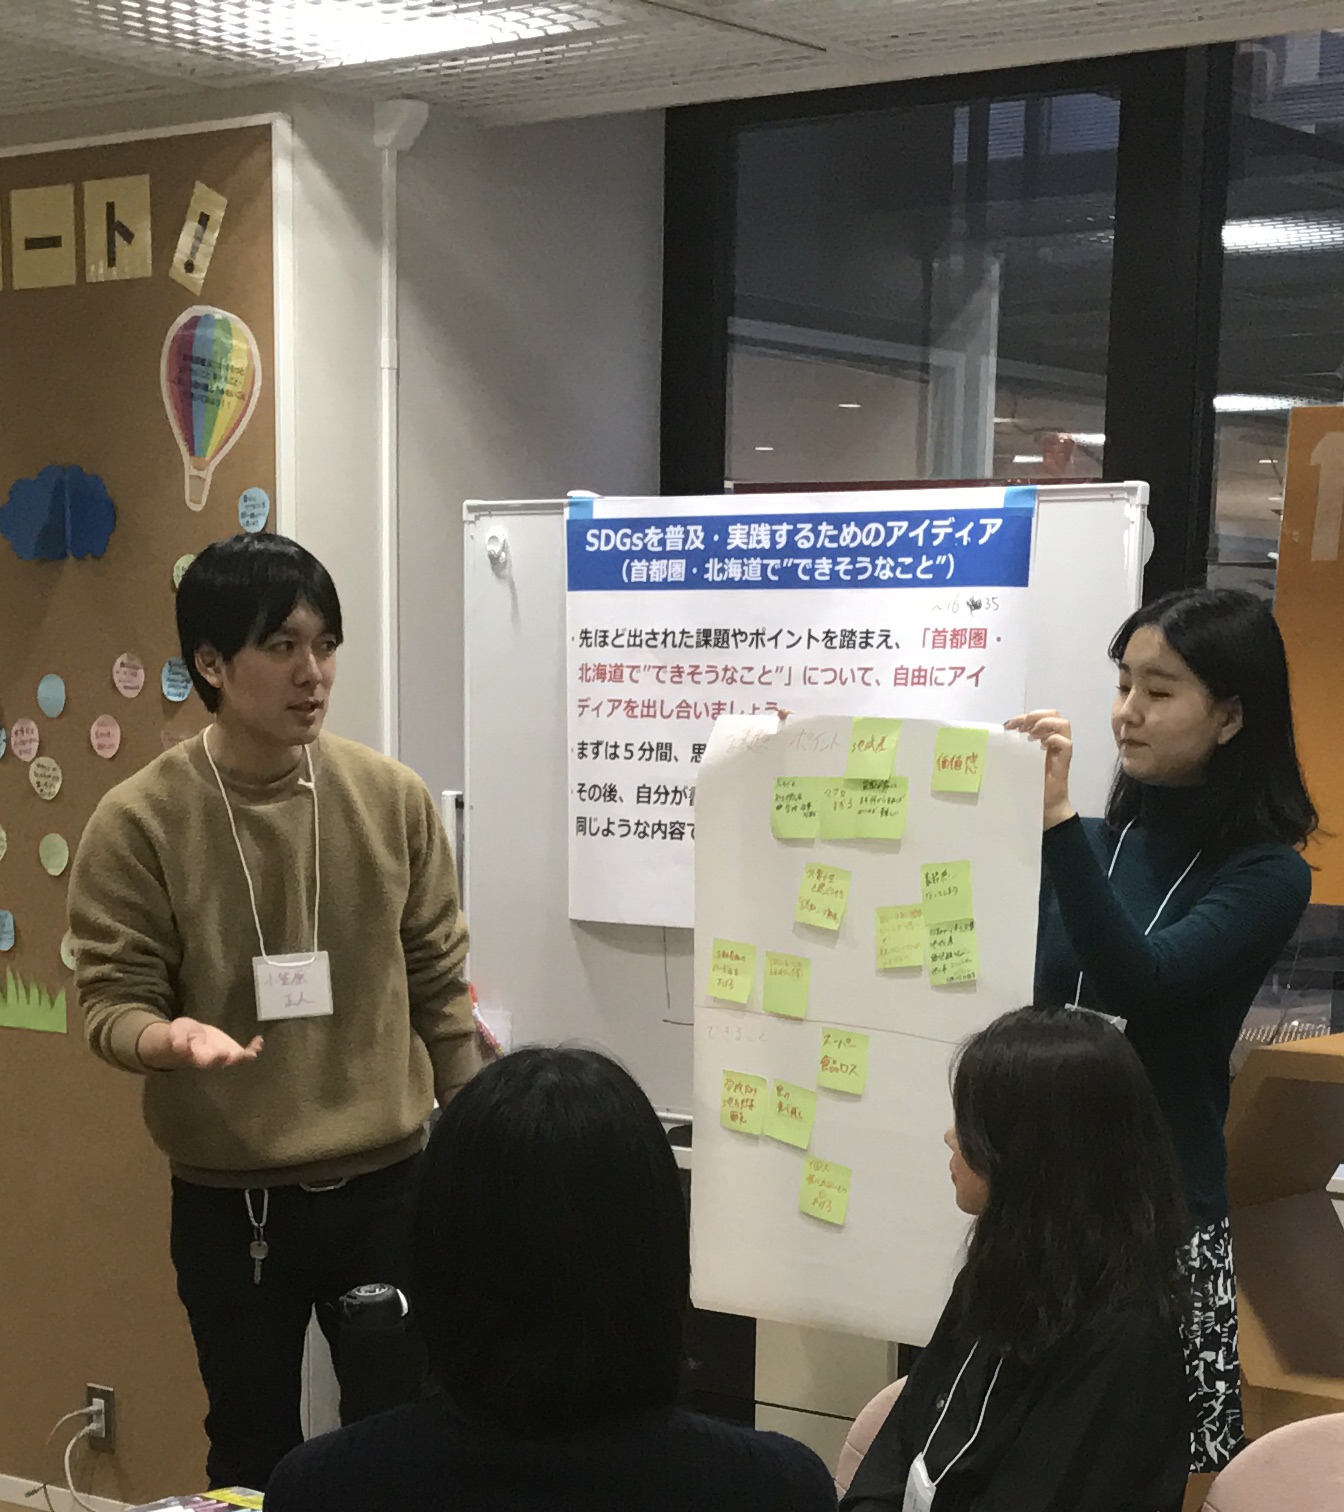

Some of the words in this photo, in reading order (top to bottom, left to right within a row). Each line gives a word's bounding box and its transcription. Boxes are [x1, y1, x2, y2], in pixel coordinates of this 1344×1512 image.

[585, 516, 1004, 552] SDGsを普及・実践するためのアイディア
